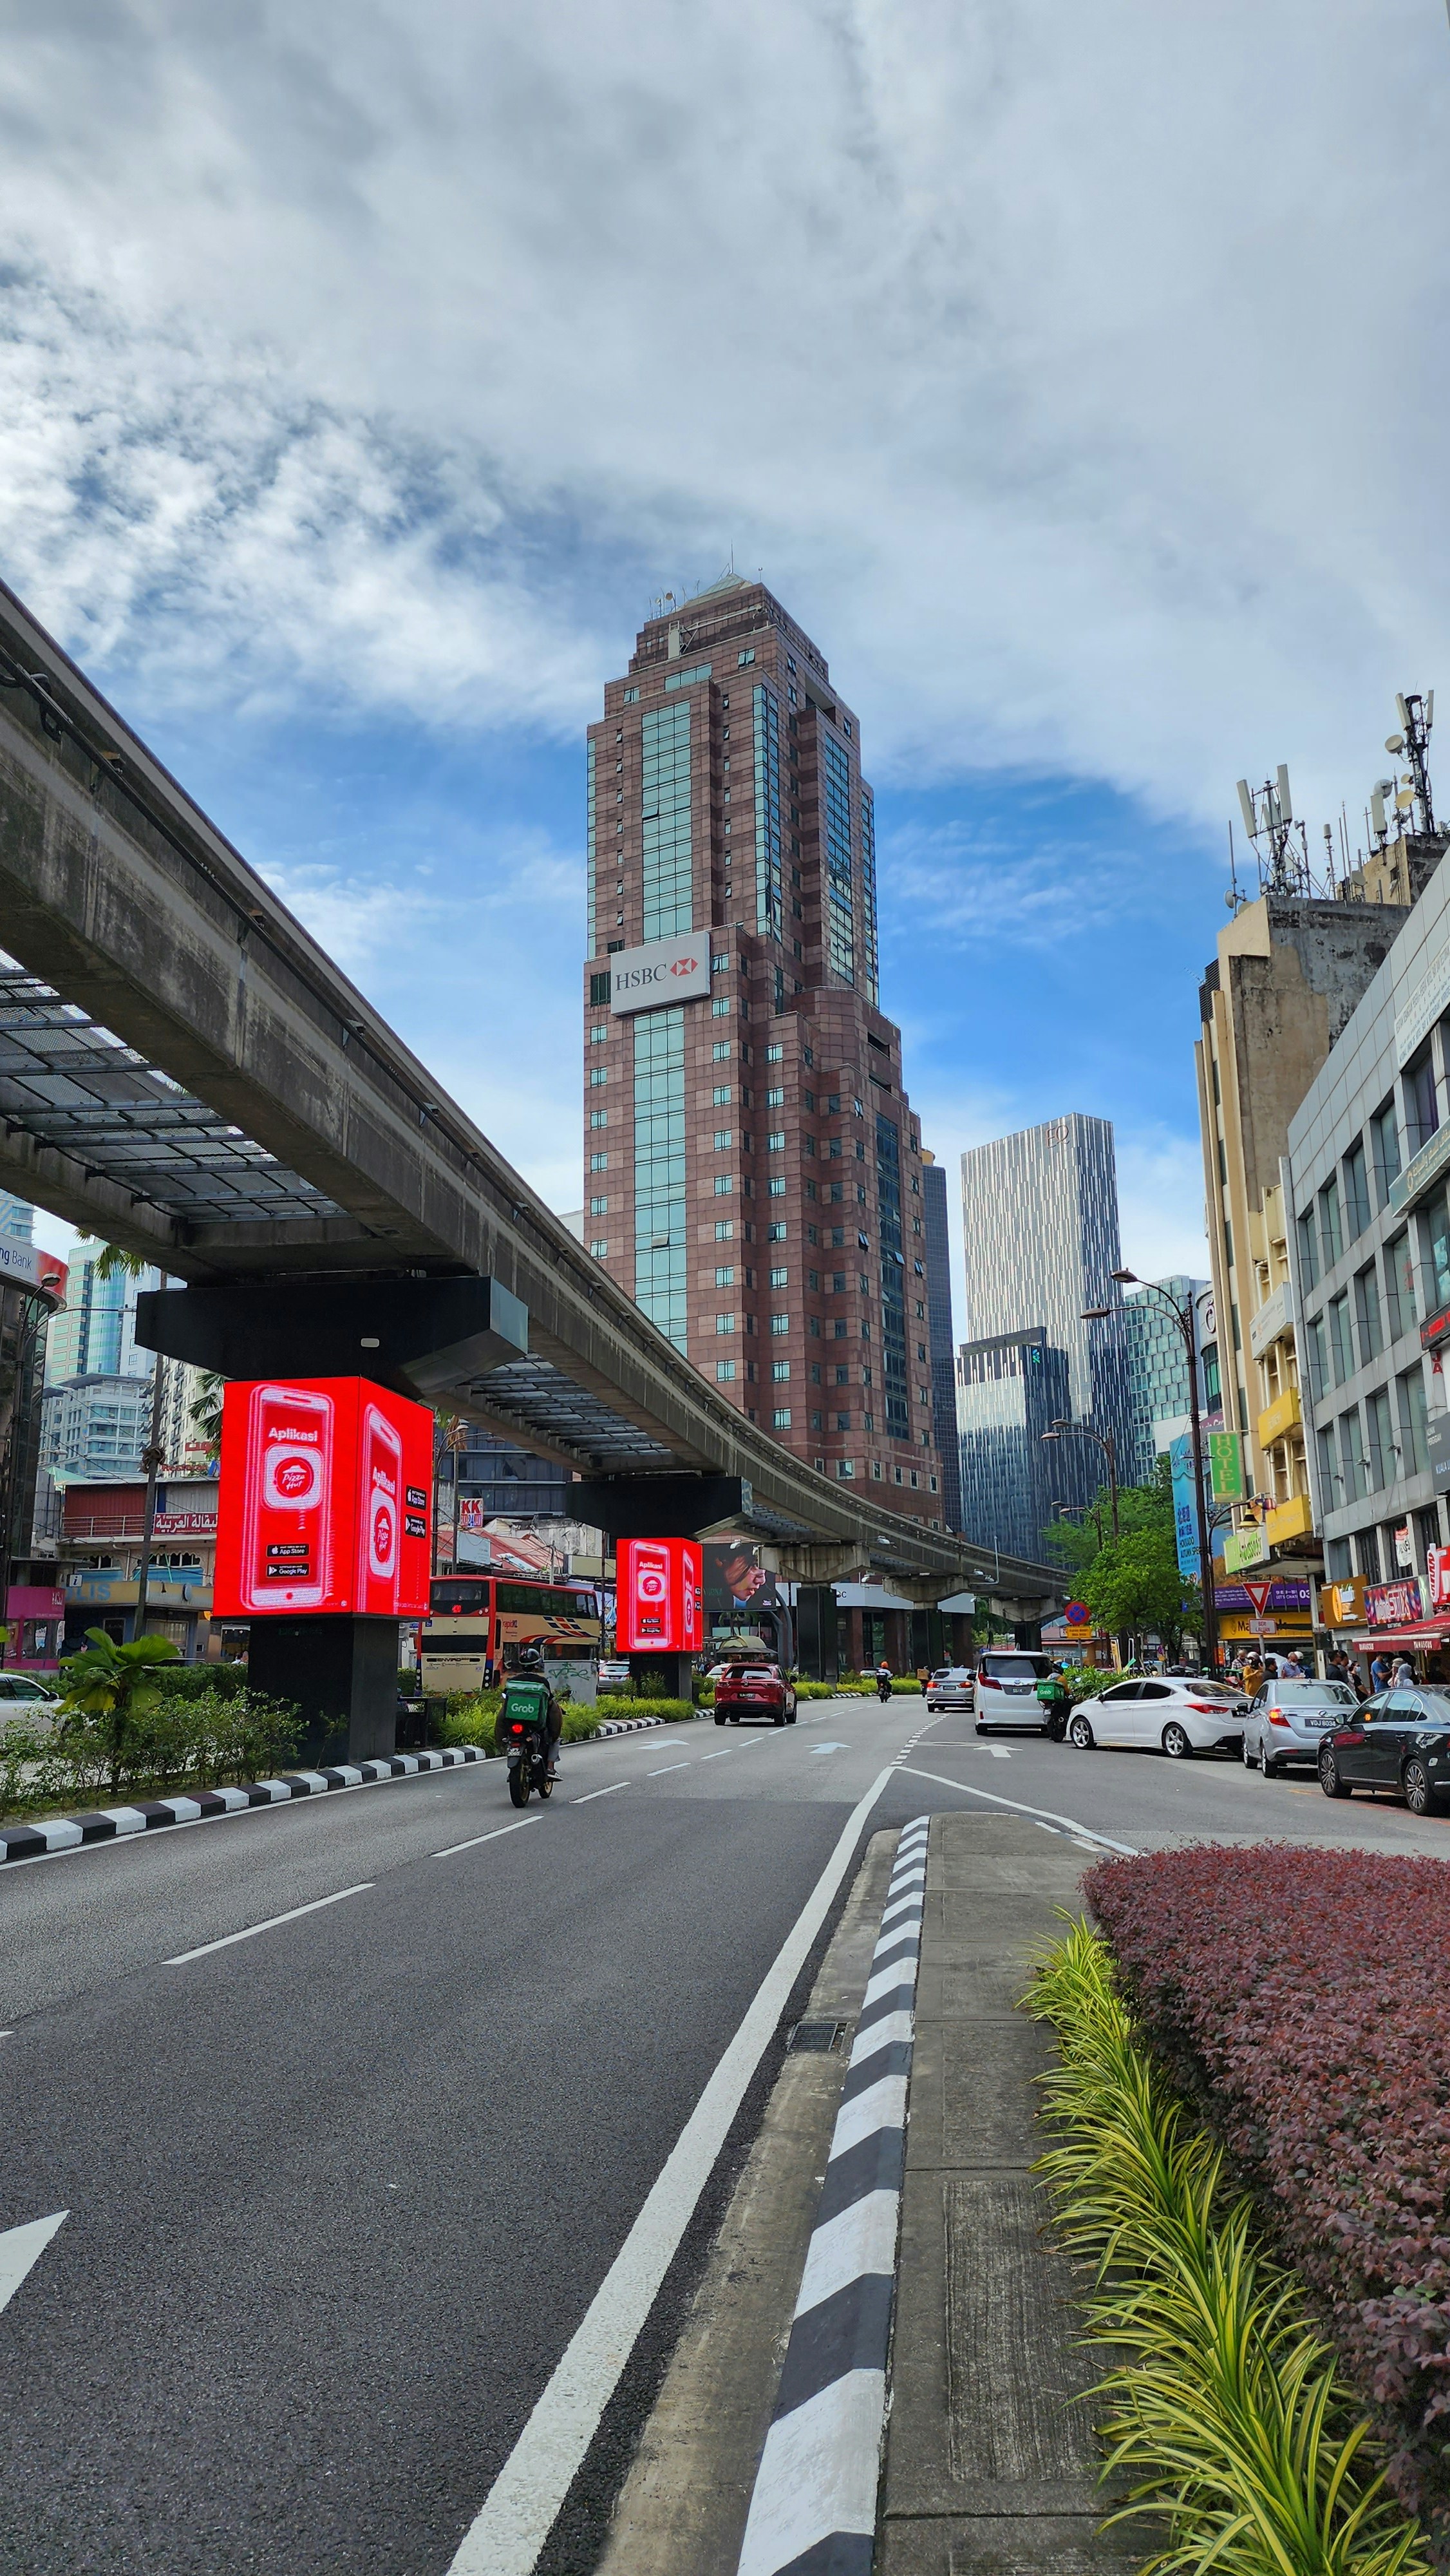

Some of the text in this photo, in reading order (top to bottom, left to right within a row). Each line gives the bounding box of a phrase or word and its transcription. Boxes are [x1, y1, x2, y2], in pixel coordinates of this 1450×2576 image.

[615, 963, 667, 991] HSBC
[12, 1250, 32, 1271] Bank
[268, 1426, 318, 1442] Aplikasi
[1216, 1434, 1236, 1494] HOTEL
[281, 1472, 306, 1484] Pizza
[372, 1465, 395, 1496] Aplikasi
[285, 1481, 303, 1491] Hut
[462, 1500, 481, 1514] KK
[639, 1561, 663, 1569] Aplikasi
[511, 1703, 534, 1714] Grab
